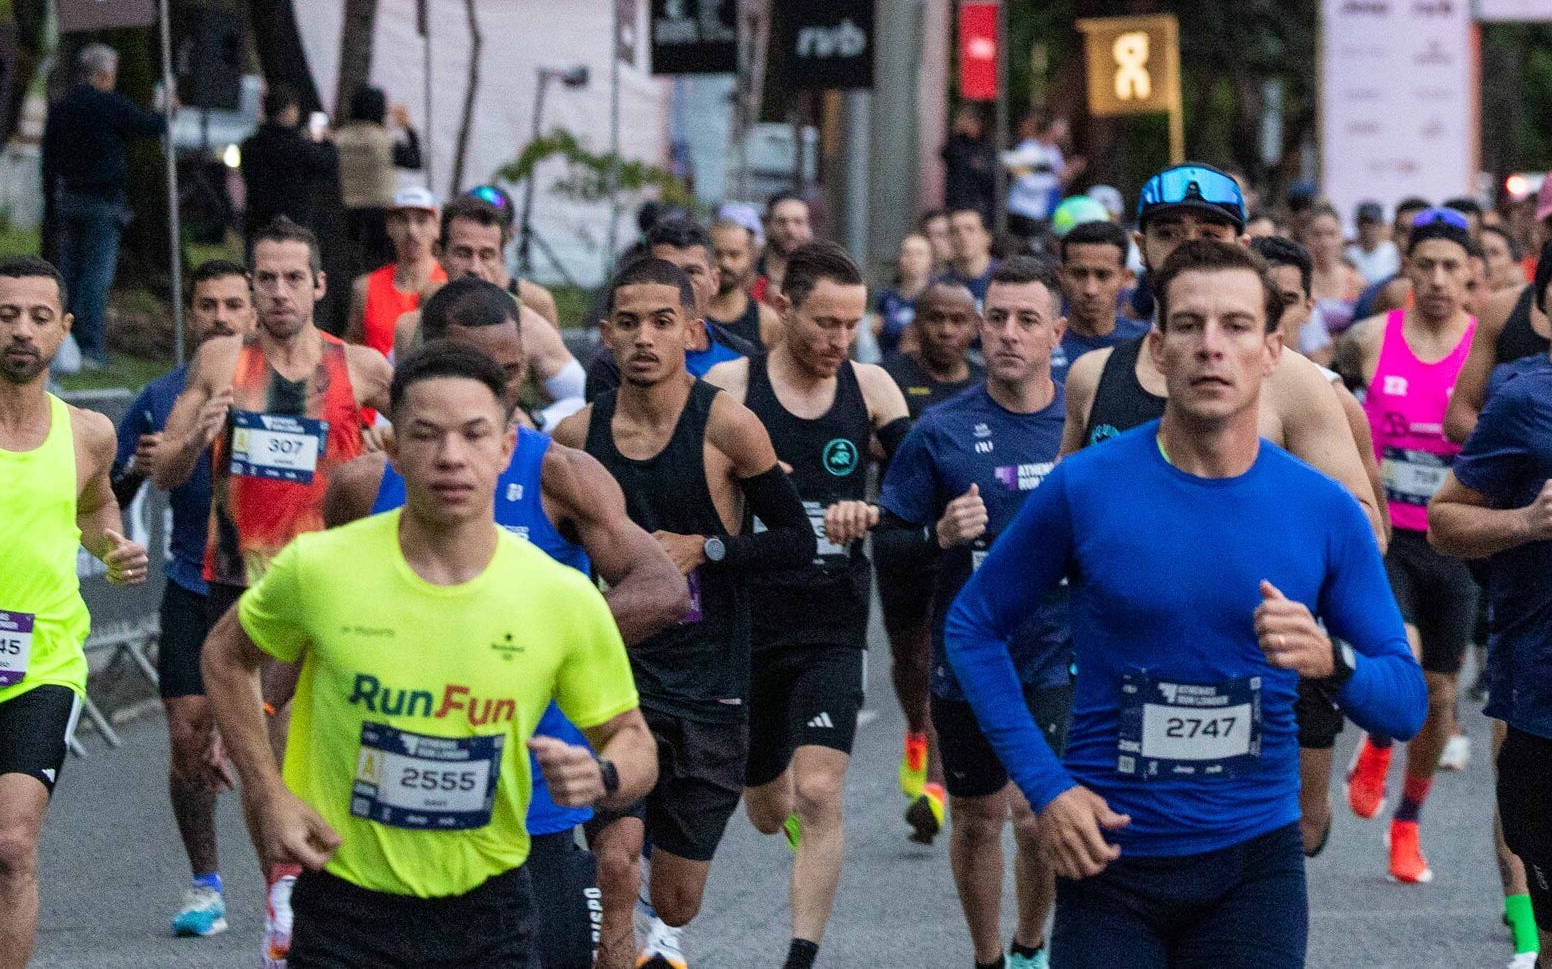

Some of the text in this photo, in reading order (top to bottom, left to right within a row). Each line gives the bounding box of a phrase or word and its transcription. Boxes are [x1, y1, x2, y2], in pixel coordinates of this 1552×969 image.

[267, 438, 304, 455] 307
[348, 672, 516, 727] RunFun
[1166, 716, 1237, 739] 2747
[401, 766, 477, 792] 2555
